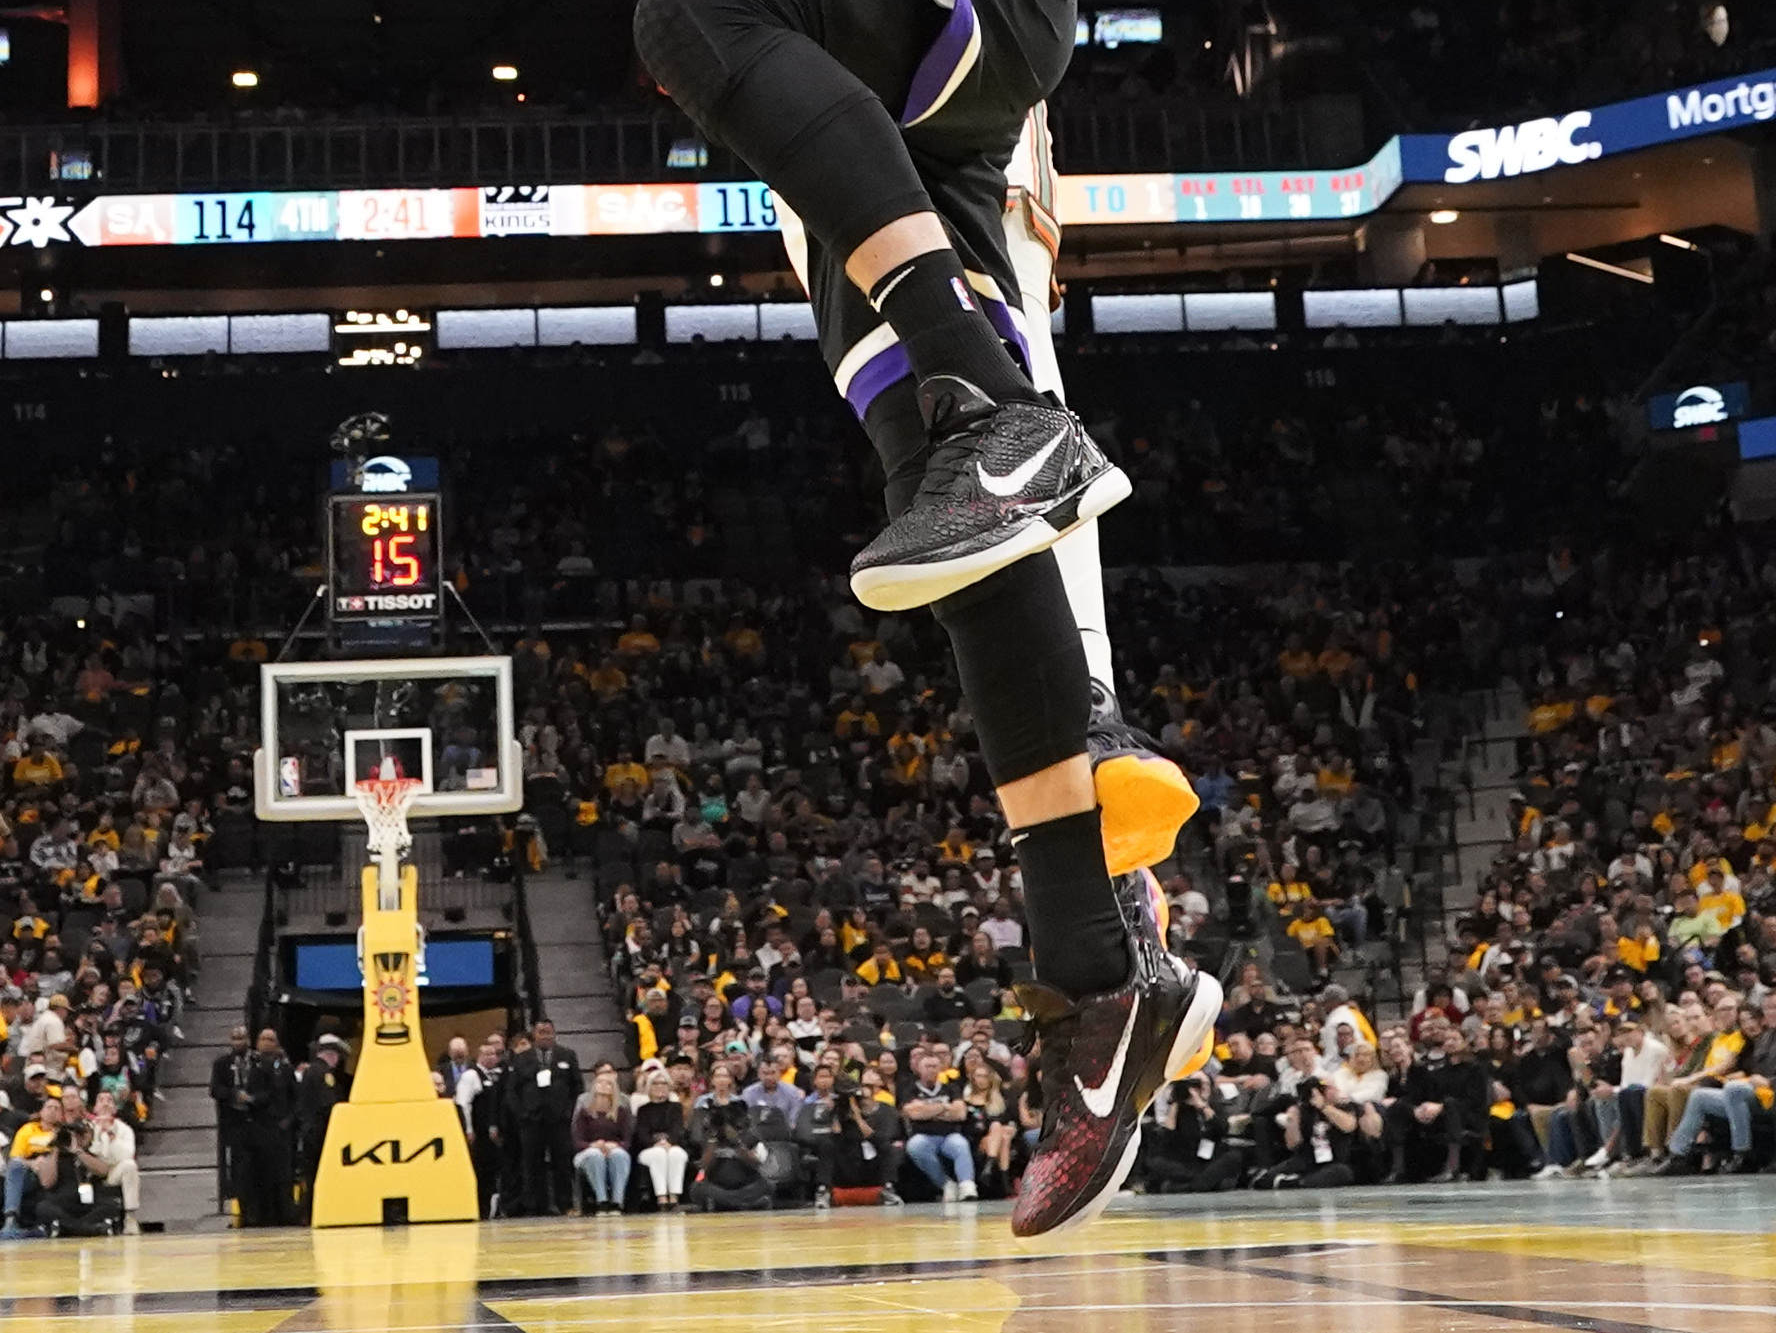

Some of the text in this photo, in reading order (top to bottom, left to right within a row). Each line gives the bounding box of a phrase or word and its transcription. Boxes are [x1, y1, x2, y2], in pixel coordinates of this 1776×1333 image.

[1667, 82, 1776, 130] Mortg
[717, 188, 777, 227] 119
[1084, 185, 1126, 214] TO
[194, 200, 256, 239] 114
[363, 197, 429, 233] 2:41
[485, 214, 551, 229] KINGS
[362, 504, 427, 535] 2:41
[373, 535, 420, 586] 15
[364, 594, 437, 611] TISSOT
